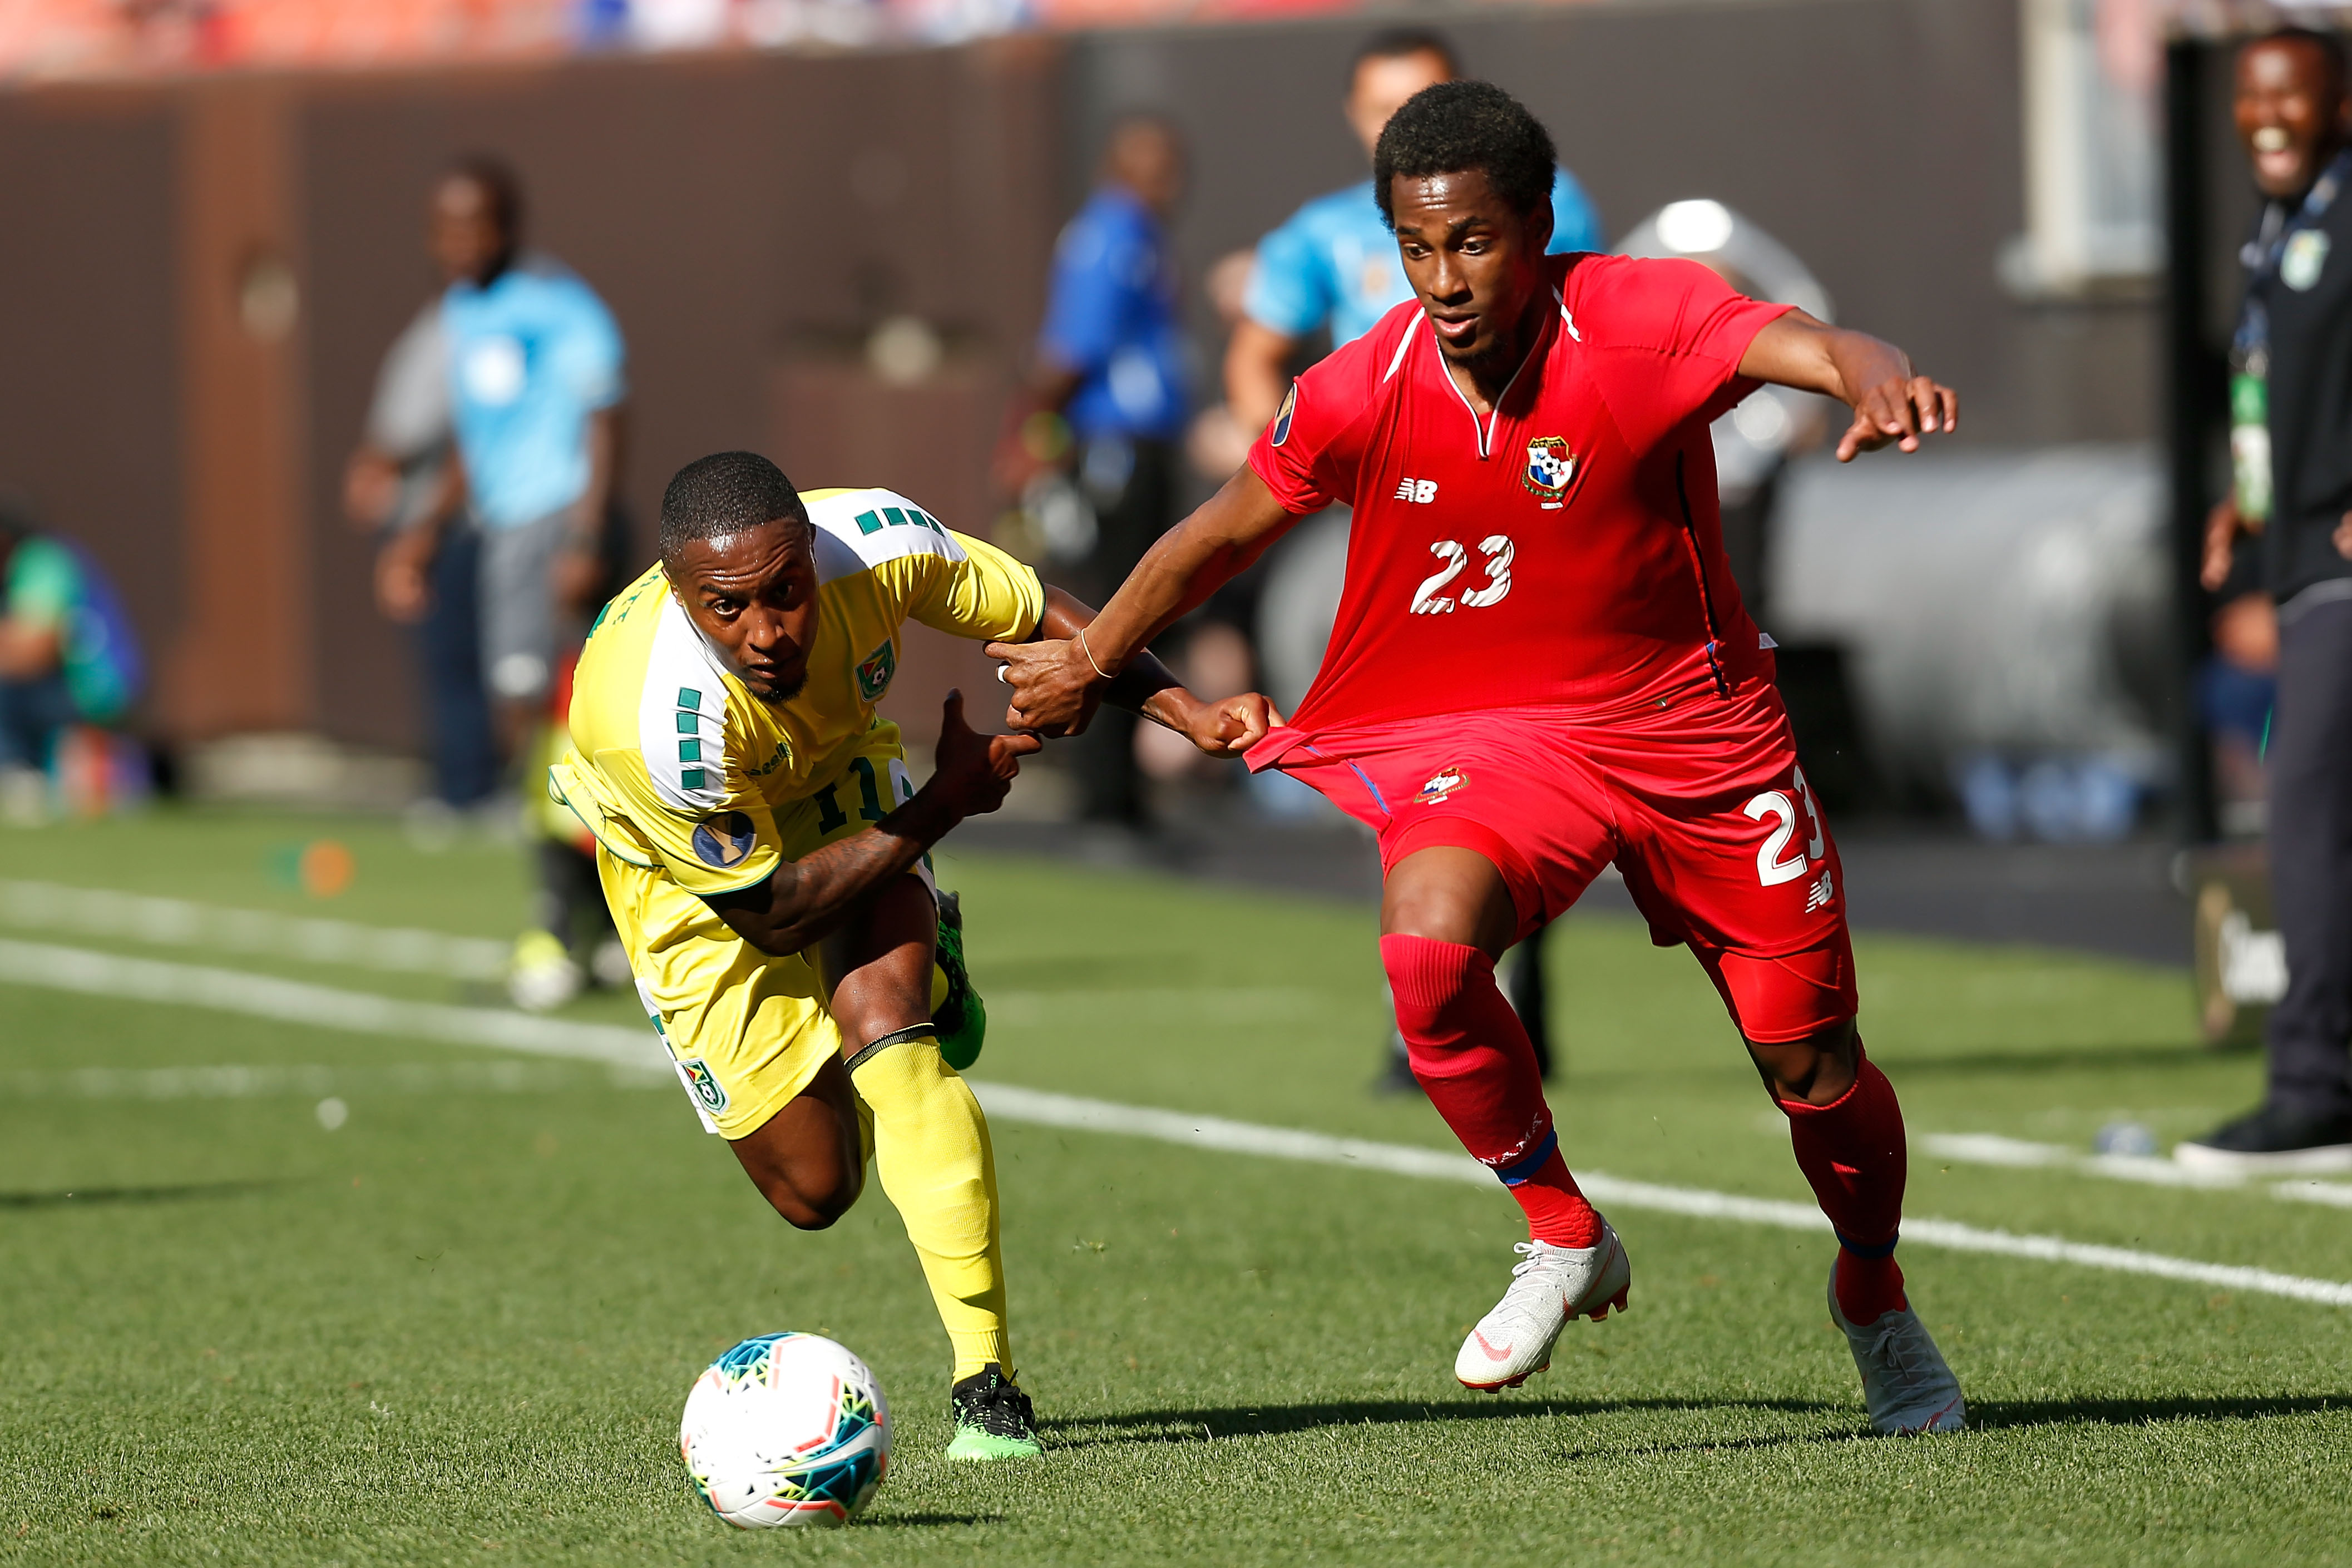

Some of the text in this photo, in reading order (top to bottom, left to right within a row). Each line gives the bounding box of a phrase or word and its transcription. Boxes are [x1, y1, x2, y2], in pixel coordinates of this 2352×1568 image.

[1394, 477, 1438, 503] NB
[1410, 535, 1514, 615] 23
[813, 756, 889, 837] 11
[1743, 765, 1824, 887] 23
